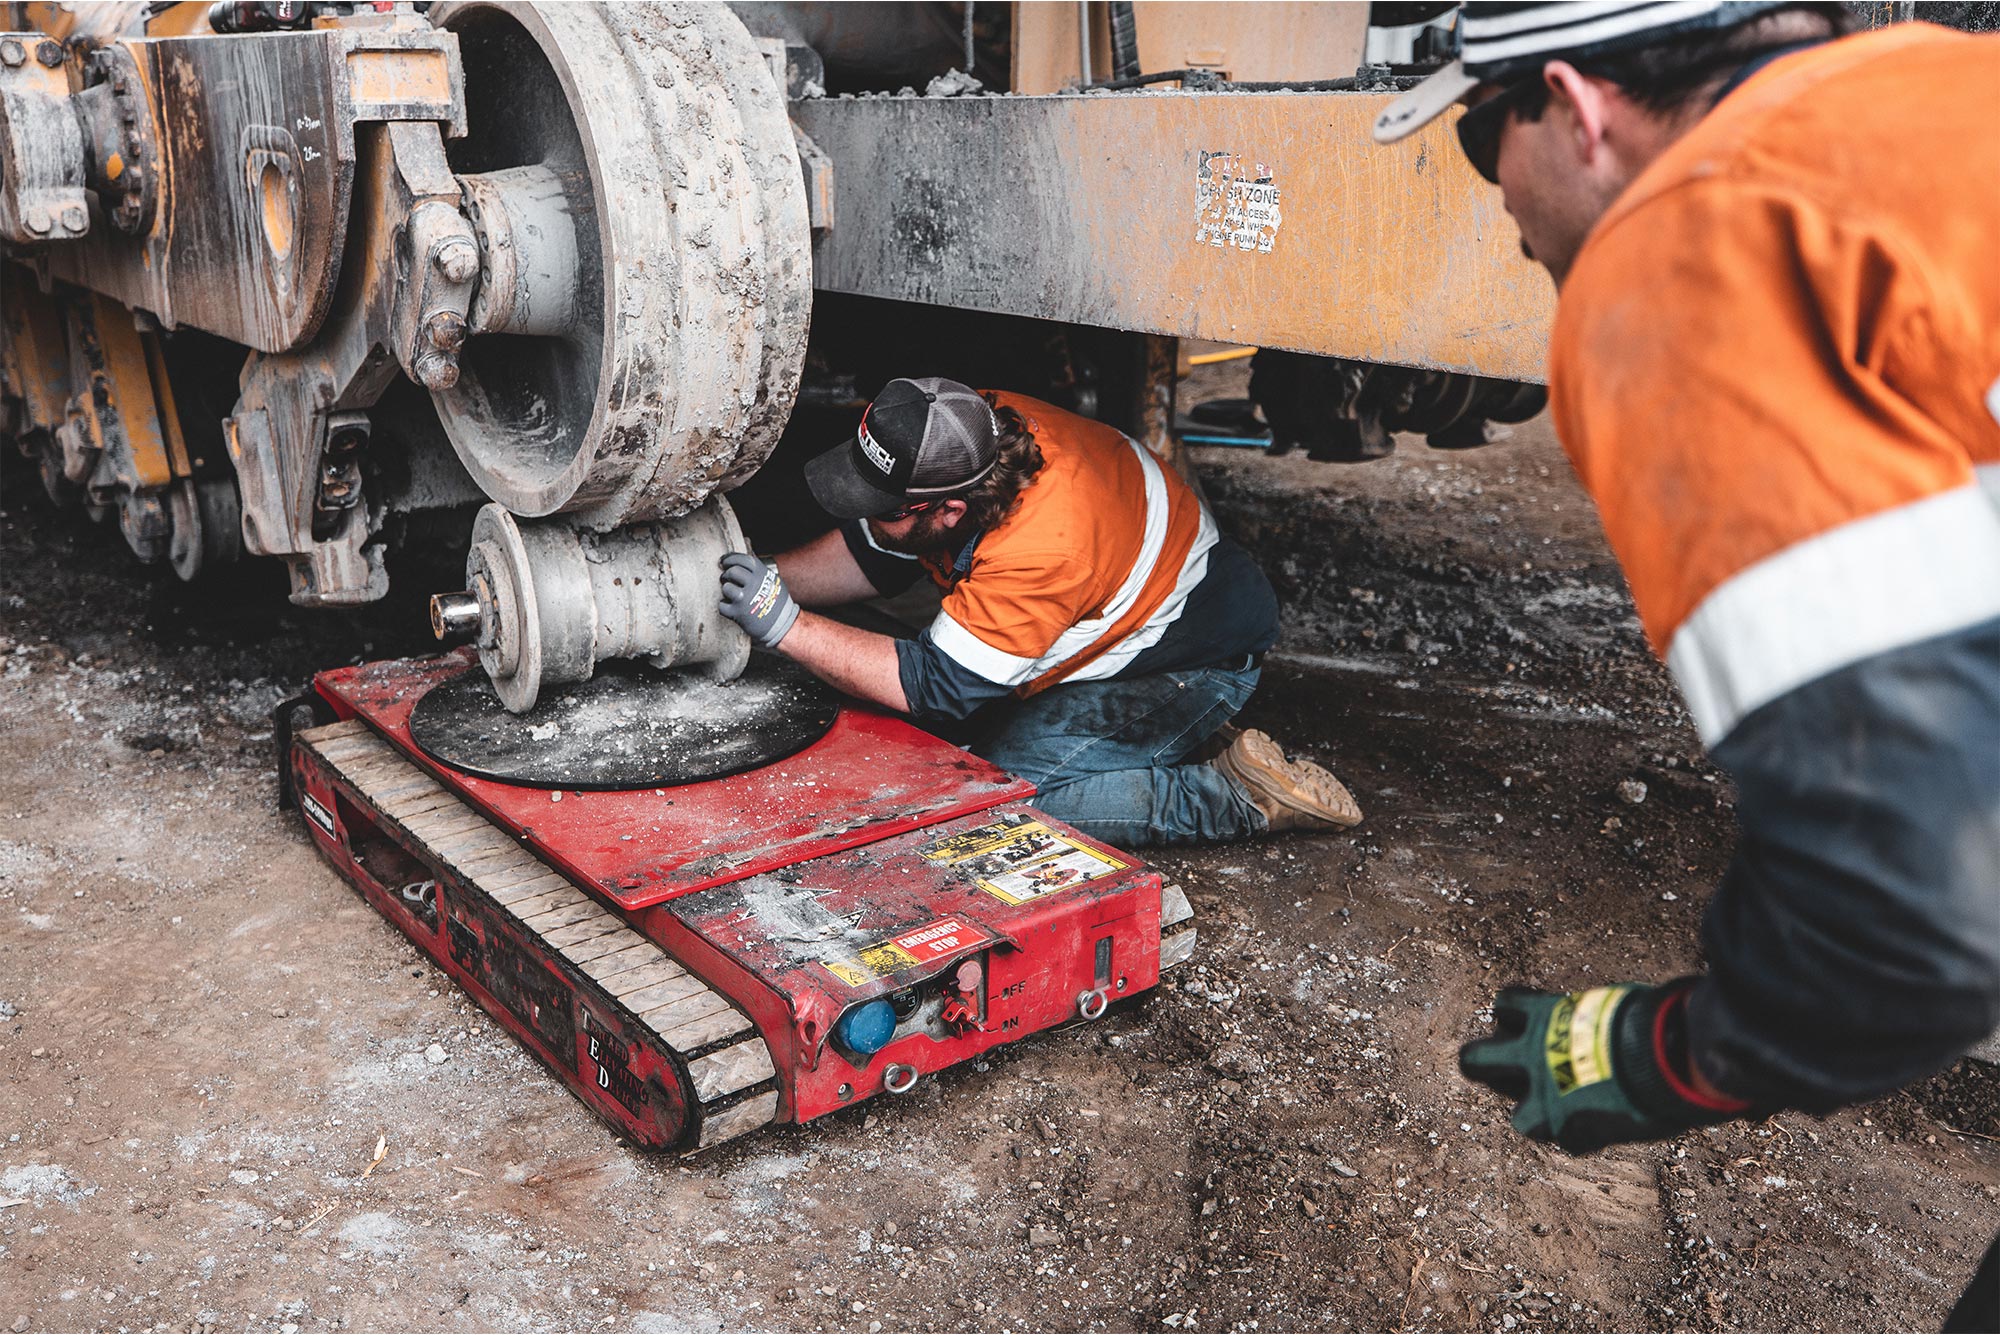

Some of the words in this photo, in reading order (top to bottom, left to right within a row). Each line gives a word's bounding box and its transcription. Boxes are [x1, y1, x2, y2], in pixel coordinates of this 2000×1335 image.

[1246, 188, 1280, 205] ZONE
[897, 921, 963, 949] EMERGENCY
[928, 936, 960, 952] STOP
[1002, 980, 1026, 1000] OFF
[1002, 1016, 1018, 1032] ON
